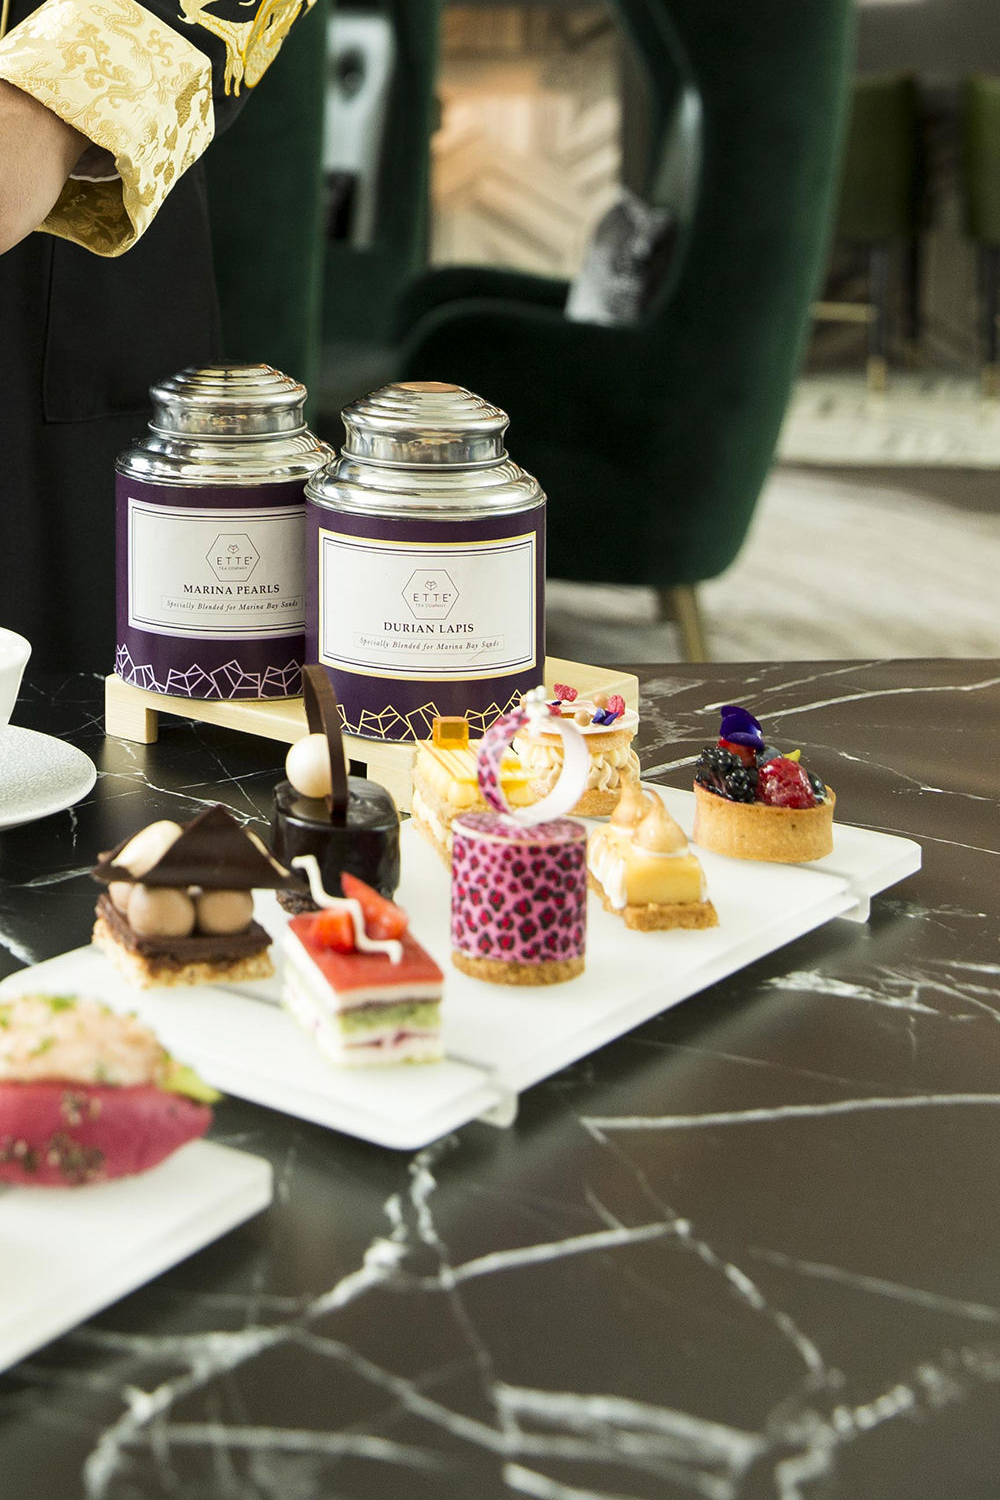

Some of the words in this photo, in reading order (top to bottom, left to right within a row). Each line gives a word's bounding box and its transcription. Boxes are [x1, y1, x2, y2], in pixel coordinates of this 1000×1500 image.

[183, 584, 233, 595] MARINA
[237, 584, 280, 595] PEARLS
[166, 600, 195, 610] Specially
[197, 603, 224, 611] Blended
[225, 604, 236, 612] for
[266, 602, 278, 610] Bay
[280, 599, 299, 608] Sands
[384, 621, 435, 634] DURIAN
[439, 623, 474, 634] LAPIS
[359, 637, 389, 648] Specially
[391, 641, 421, 650] Blended
[422, 642, 433, 651] for
[436, 642, 463, 650] Marina
[465, 642, 478, 650] Bay
